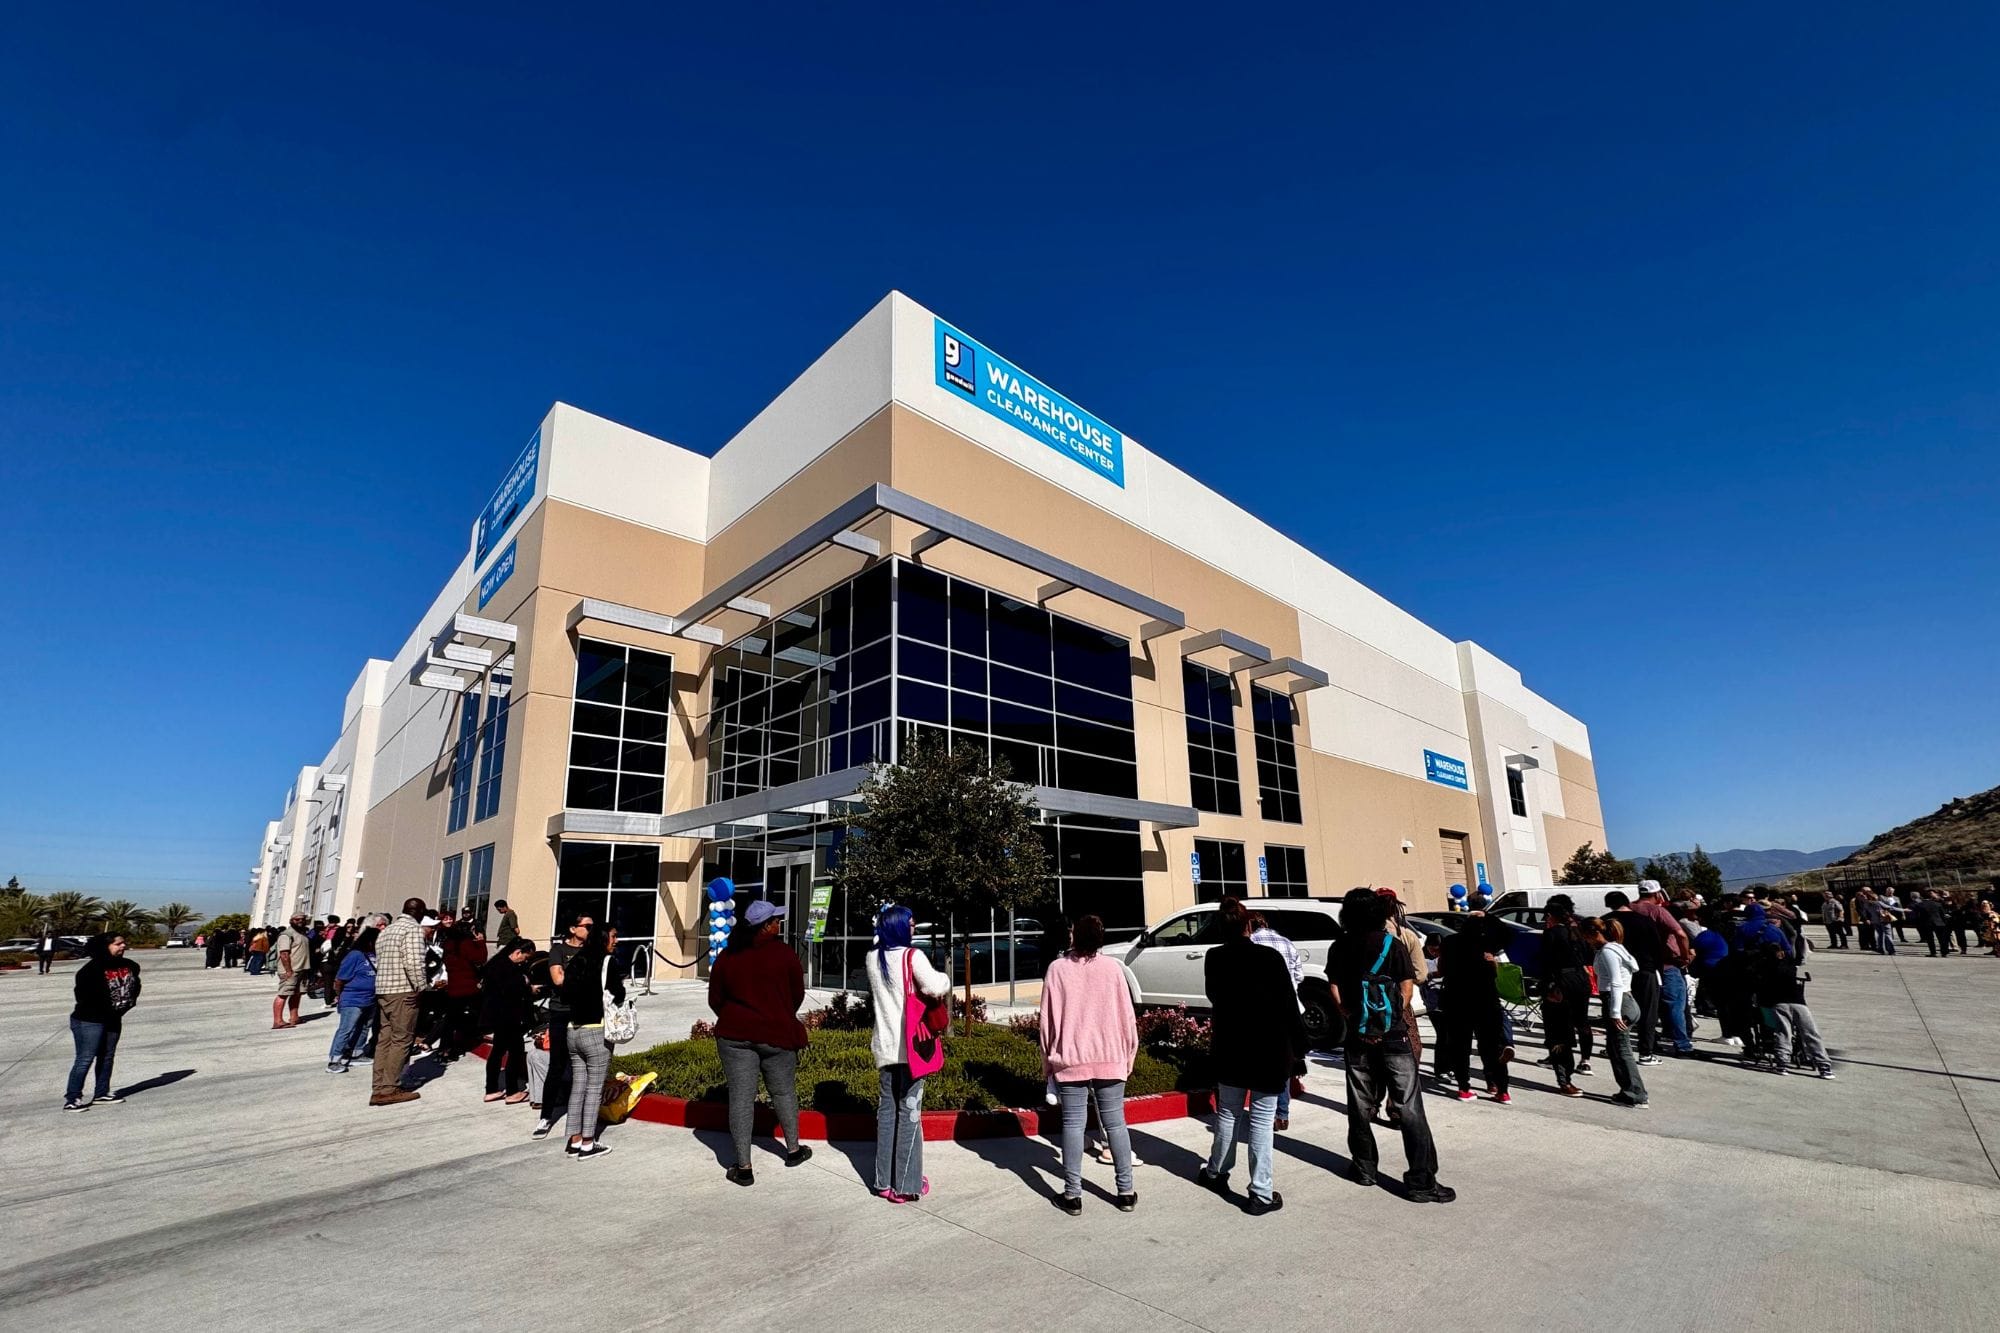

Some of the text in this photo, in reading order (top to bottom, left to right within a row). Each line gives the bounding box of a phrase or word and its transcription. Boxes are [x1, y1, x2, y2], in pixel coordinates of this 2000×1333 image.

[945, 335, 960, 366] g
[986, 361, 1113, 455] WAREHOUSE
[986, 389, 1115, 473] CLEARANCE CENTER
[493, 441, 537, 516] WAREHOUSE
[481, 572, 496, 599] NOW
[496, 550, 514, 582] OPEN
